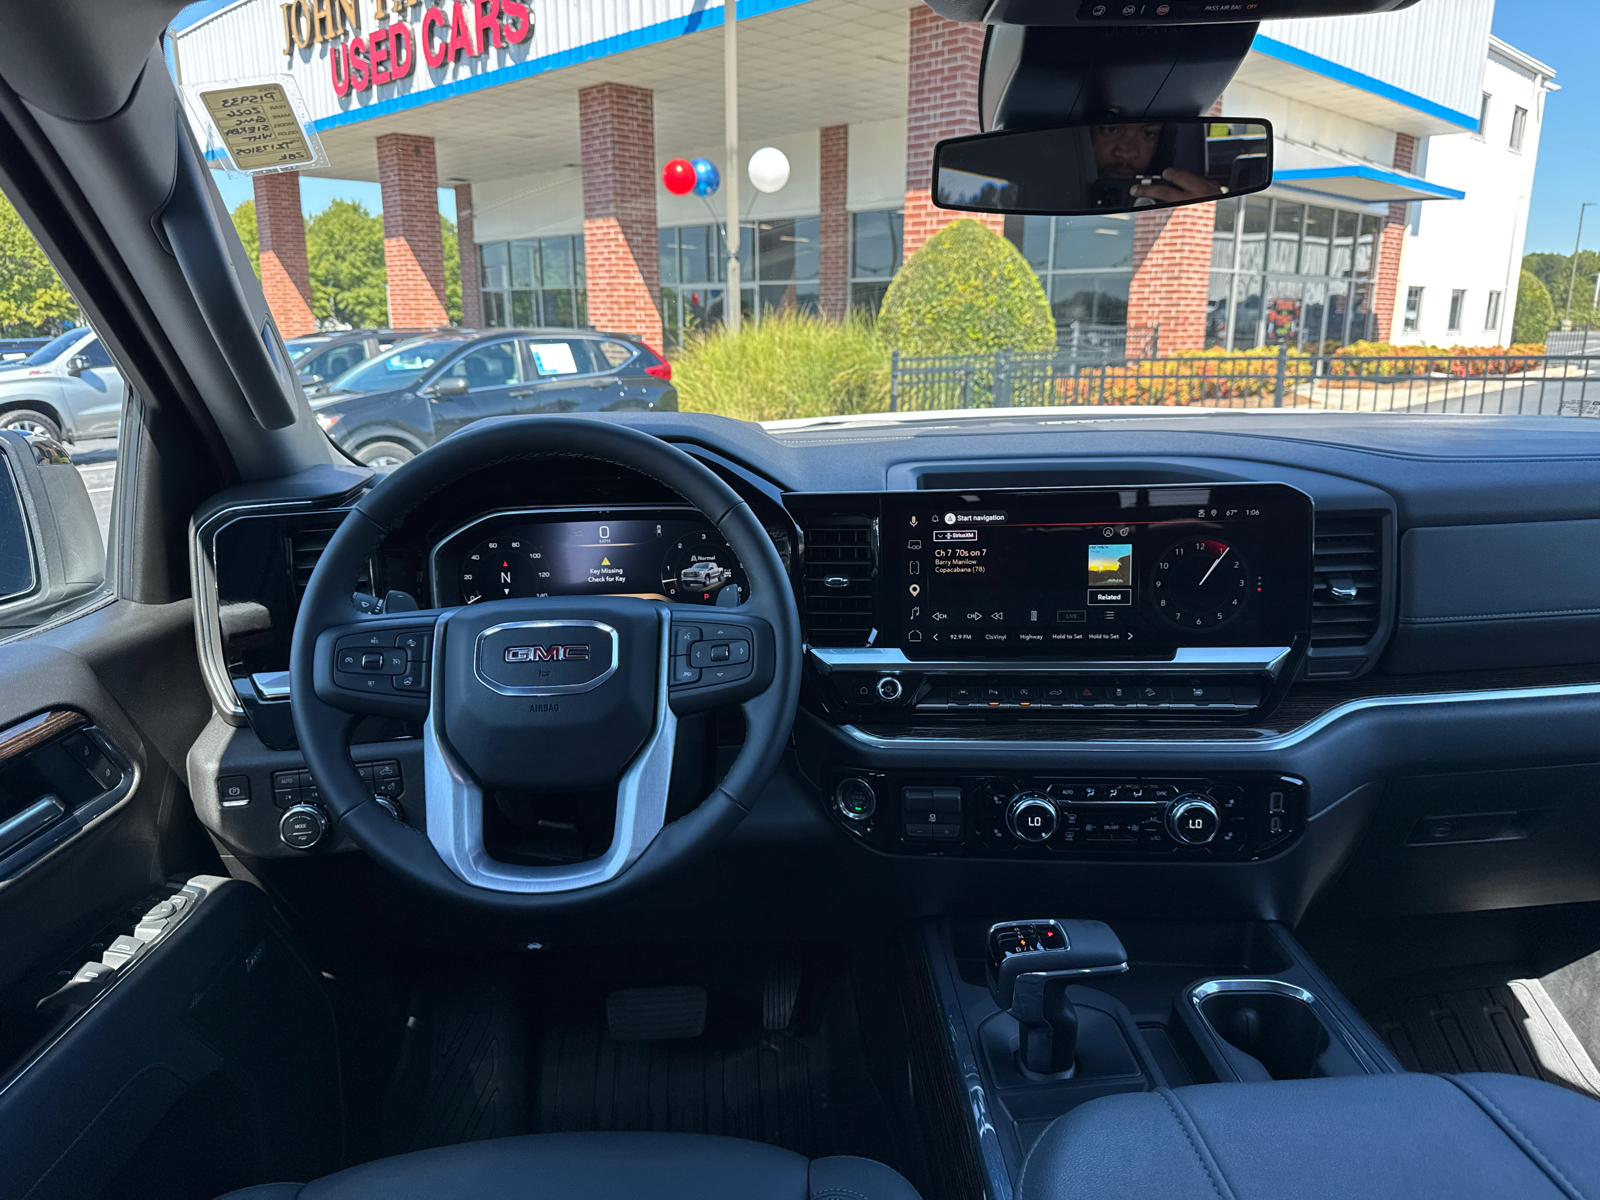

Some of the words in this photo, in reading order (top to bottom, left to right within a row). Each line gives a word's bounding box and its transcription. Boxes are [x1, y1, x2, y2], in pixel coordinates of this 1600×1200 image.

[280, 0, 356, 55] JOHN
[330, 22, 413, 97] USED
[422, 0, 531, 68] CARS
[973, 514, 1005, 522] navigation
[599, 526, 609, 538] 0
[935, 549, 945, 557] Ch
[1176, 548, 1184, 556] 11
[1160, 562, 1169, 570] 10
[501, 572, 511, 583] N
[504, 645, 589, 662] GMC
[529, 704, 559, 712] AIRBAG
[1028, 817, 1041, 826] LO
[1189, 819, 1202, 828] LO
